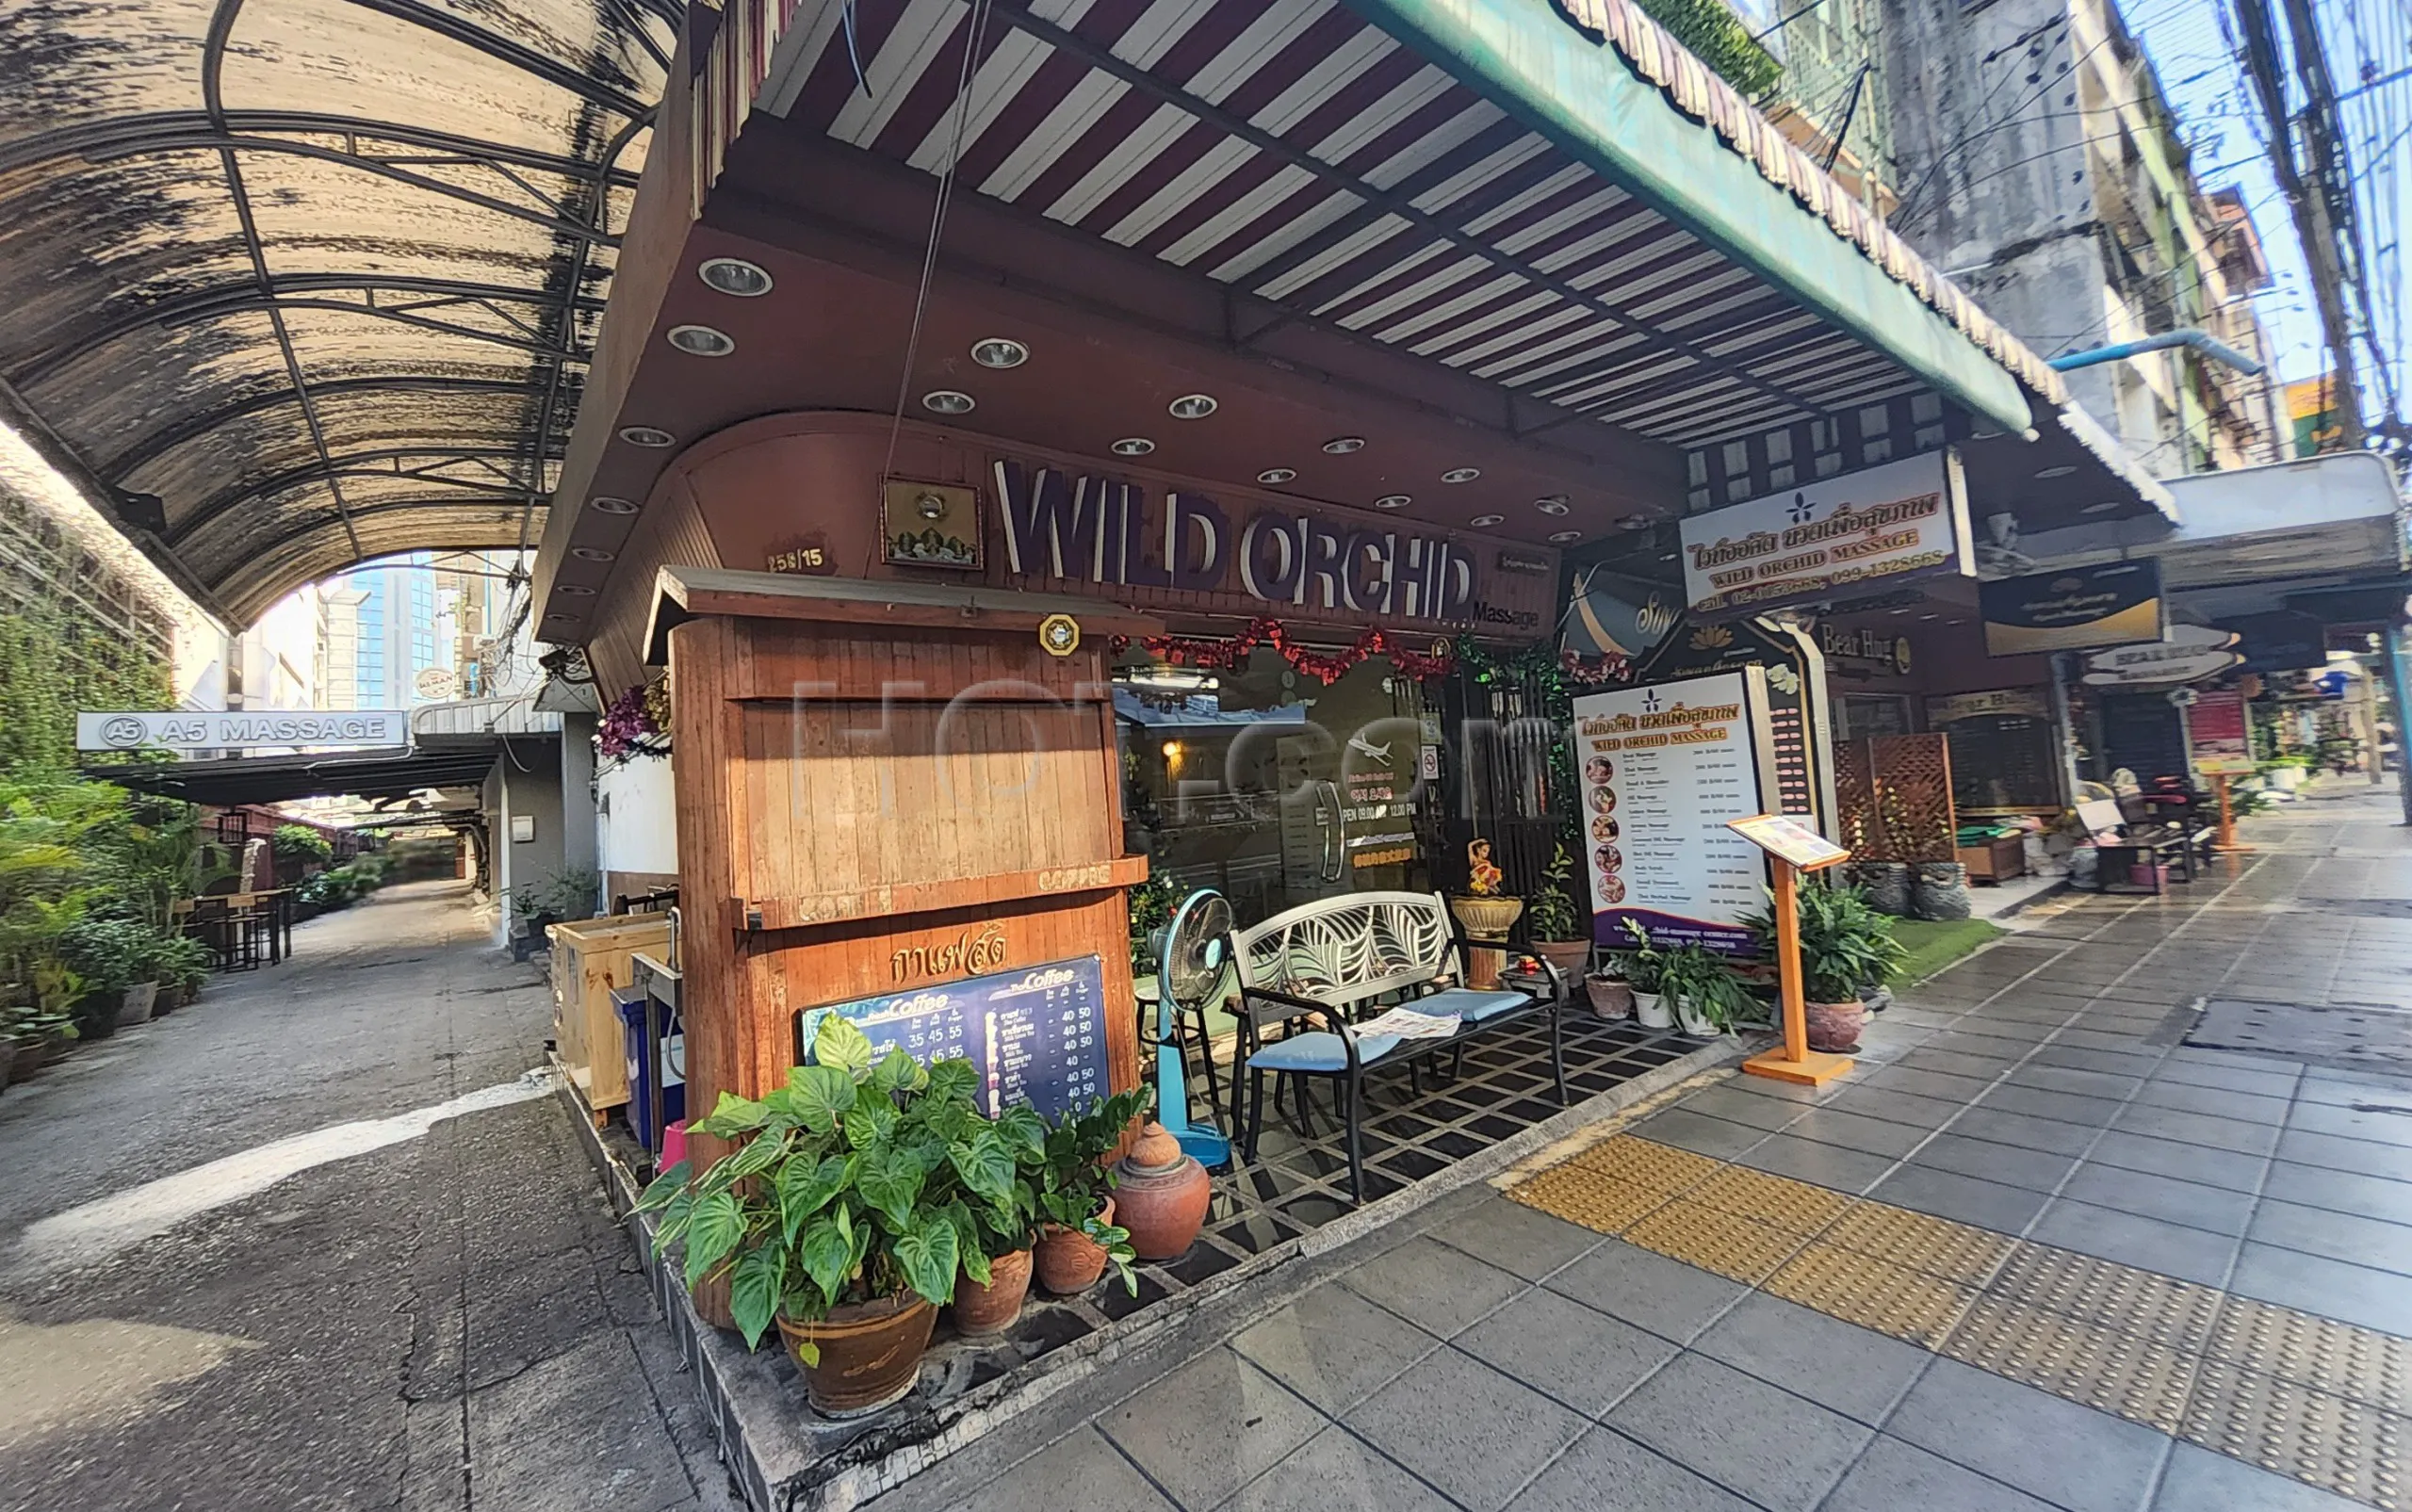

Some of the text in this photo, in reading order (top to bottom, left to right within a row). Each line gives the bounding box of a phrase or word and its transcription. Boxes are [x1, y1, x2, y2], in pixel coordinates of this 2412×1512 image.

[994, 460, 1480, 622] WILD ORCHID
[1710, 528, 1918, 589] WILD ORCHID MASSAGE
[1472, 600, 1540, 630] Massage
[1821, 624, 1893, 666] Bear Hug
[106, 721, 139, 740] A5
[162, 719, 386, 741] A5 MASSAGE
[1591, 727, 1727, 752] WILD ORCHID MASSAGE
[1024, 968, 1075, 990] Coffee
[888, 993, 950, 1017] Coffee
[1062, 1006, 1091, 1021] 40 50
[908, 1025, 963, 1049] 35 45 55
[1063, 1021, 1092, 1037] 40 50
[949, 1045, 964, 1059] 55
[1064, 1035, 1092, 1051] 40 50
[1066, 1055, 1079, 1066] 40
[1067, 1067, 1095, 1083] 40 50
[1067, 1081, 1095, 1098] 40 50
